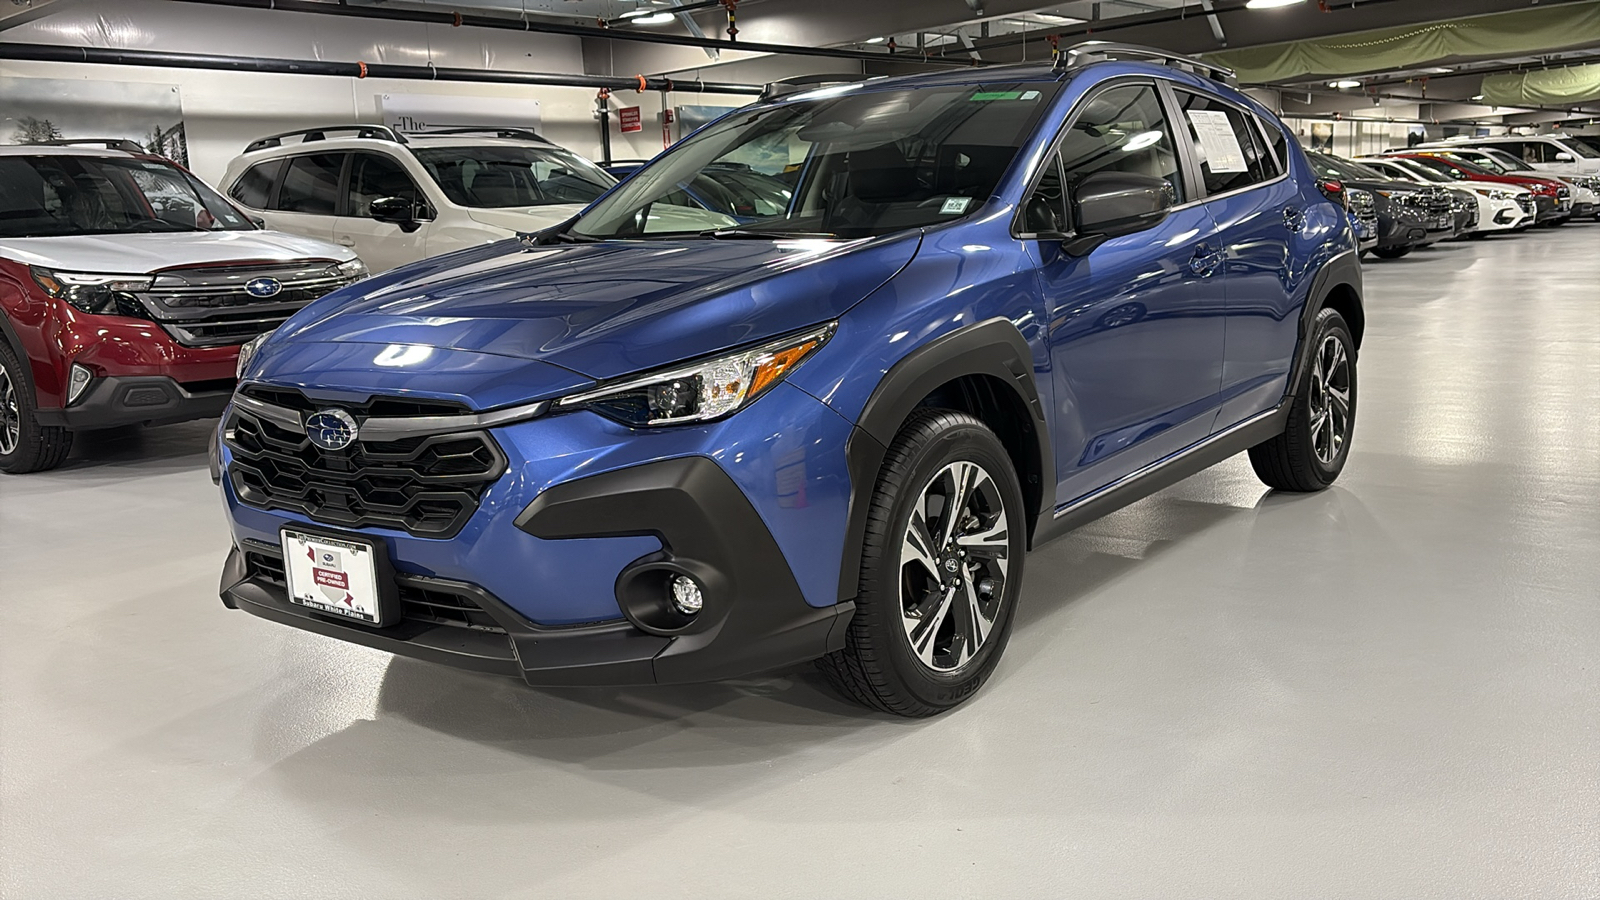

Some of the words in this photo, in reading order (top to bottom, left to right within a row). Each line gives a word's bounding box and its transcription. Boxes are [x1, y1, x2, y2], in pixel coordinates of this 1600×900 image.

[398, 116, 426, 131] The
[316, 576, 346, 587] PRE-OWNED
[318, 570, 343, 580] CERTIFIED
[302, 599, 324, 609] Subaru
[324, 604, 343, 614] White
[344, 609, 364, 619] Plains
